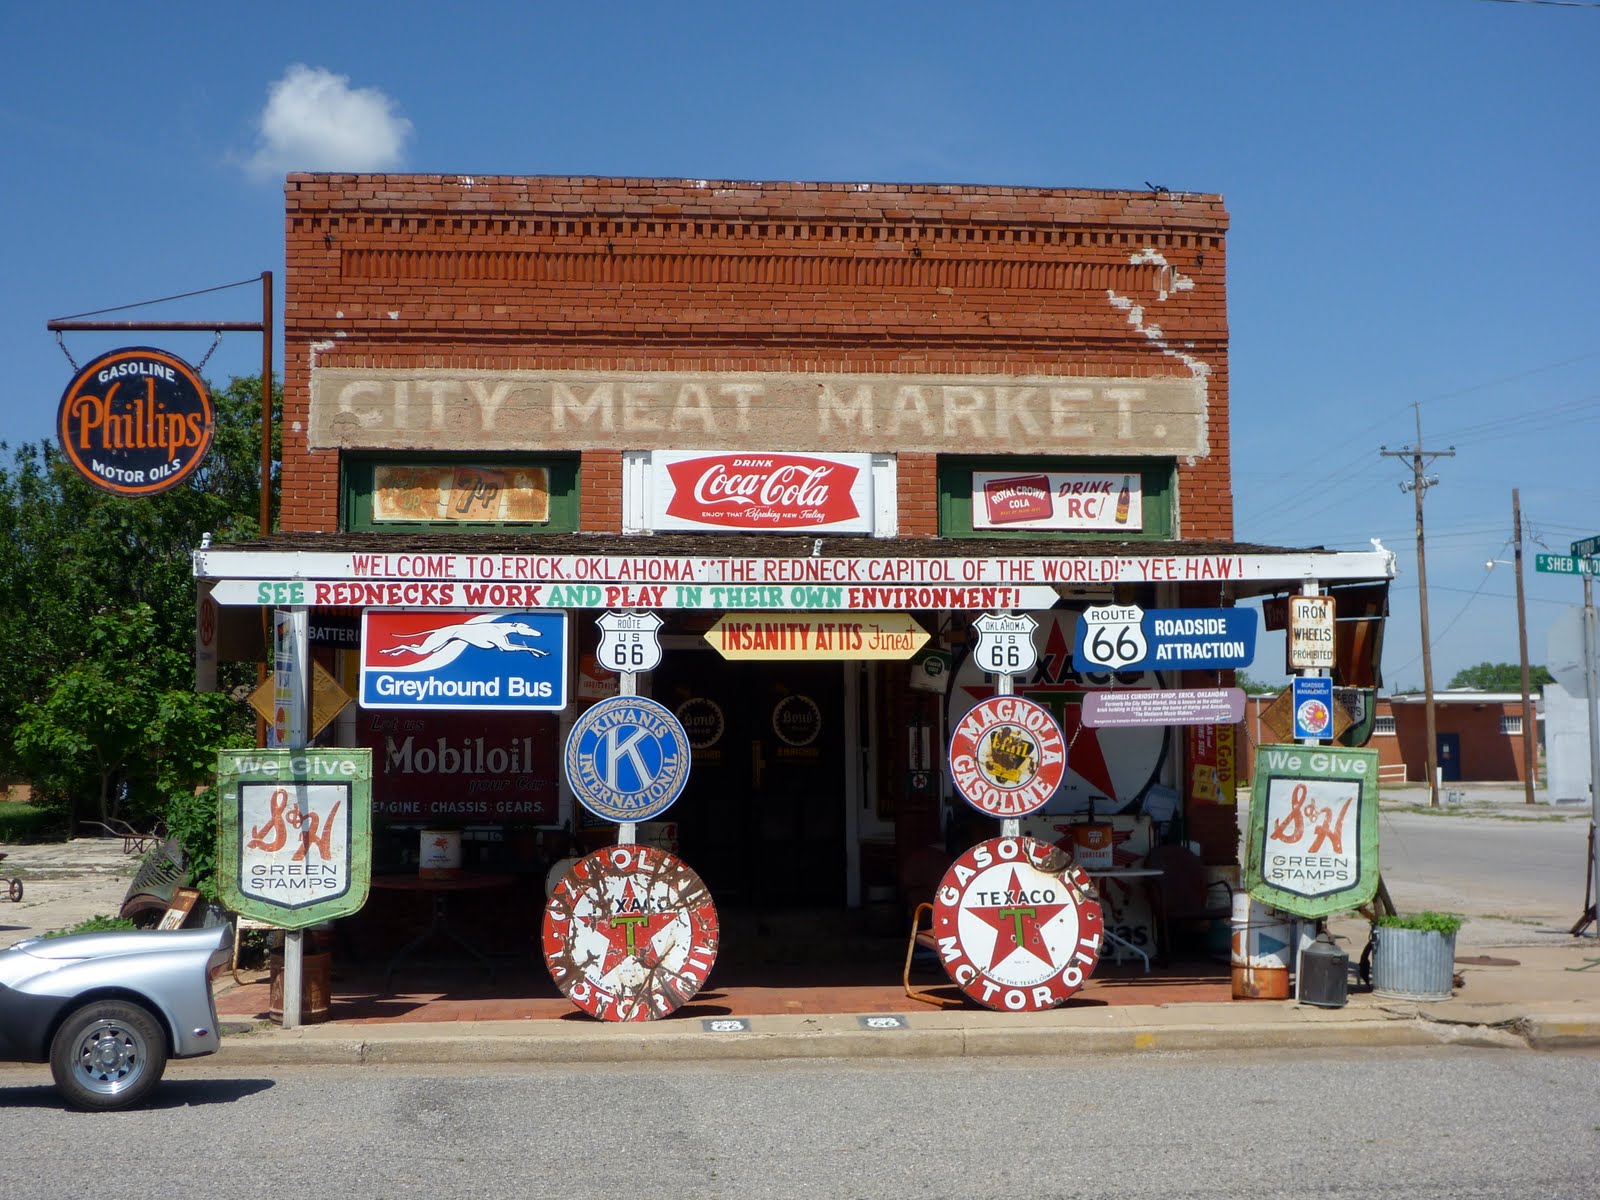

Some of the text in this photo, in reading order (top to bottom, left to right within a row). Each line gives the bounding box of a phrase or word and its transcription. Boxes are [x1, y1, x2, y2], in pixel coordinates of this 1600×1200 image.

[98, 361, 175, 384] GASOLINE
[337, 380, 514, 432] CITY
[551, 382, 765, 433] MEAT
[72, 377, 202, 462] Phillips
[92, 458, 182, 482] MOTOR OILS
[732, 459, 774, 467] DRINK
[693, 463, 834, 507] Coca-Cola
[991, 485, 1046, 505] ROYAL CROWN
[1058, 481, 1114, 498] DRINK
[1009, 499, 1030, 509] COLA
[744, 508, 781, 523] Refreshing
[799, 508, 825, 523] Feeling
[352, 554, 456, 579] WELCOME
[466, 556, 494, 579] TO
[575, 558, 695, 580] OKLAHOMA
[764, 559, 857, 581] REDNECK
[869, 559, 955, 581] CAPITOL
[962, 559, 987, 581] OF
[996, 559, 1034, 581] THE
[1138, 559, 1178, 580] YEE
[1547, 556, 1573, 572] SHEB
[258, 582, 1020, 609] SEE REDNECKS WORK AND PLAY IN THEIR OWN ENVIRONMENT!
[1091, 610, 1135, 620] ROUTE
[1298, 605, 1327, 619] IRON
[617, 619, 641, 629] ROUTE
[985, 620, 1025, 631] OKLAHOMA
[1155, 618, 1227, 636] ROADSIDE
[721, 622, 917, 651] INSANITY AT ITS Finest
[1091, 624, 1138, 662] 66
[1293, 628, 1332, 641] WHEELS
[614, 644, 643, 665] 66
[991, 645, 1019, 667] 66
[1156, 641, 1245, 661] ATTRACTION
[1293, 649, 1333, 660] PROHIBITED
[376, 674, 552, 701] Greyhound Bus
[589, 709, 669, 739] KIWANIS
[958, 699, 1062, 766] MAGNOLIA
[384, 736, 534, 774] Mobiloil
[604, 724, 657, 792] K
[1267, 751, 1301, 771] We
[235, 757, 277, 776] We
[579, 752, 678, 809] INTERNATIONAL
[953, 755, 1053, 814] GASOLINE
[430, 801, 487, 813] CHASSIS
[247, 788, 342, 862] S&H
[1270, 783, 1353, 854] S&H
[251, 864, 337, 876] GREEN
[1272, 855, 1348, 868] GREEN
[251, 877, 337, 890] STAMPS
[1272, 868, 1348, 881] STAMPS
[977, 889, 1056, 906] TEXACO
[938, 936, 1053, 1009] MOTOR
[1062, 934, 1100, 987] OIL
[1040, 963, 1062, 981] COMPANY
